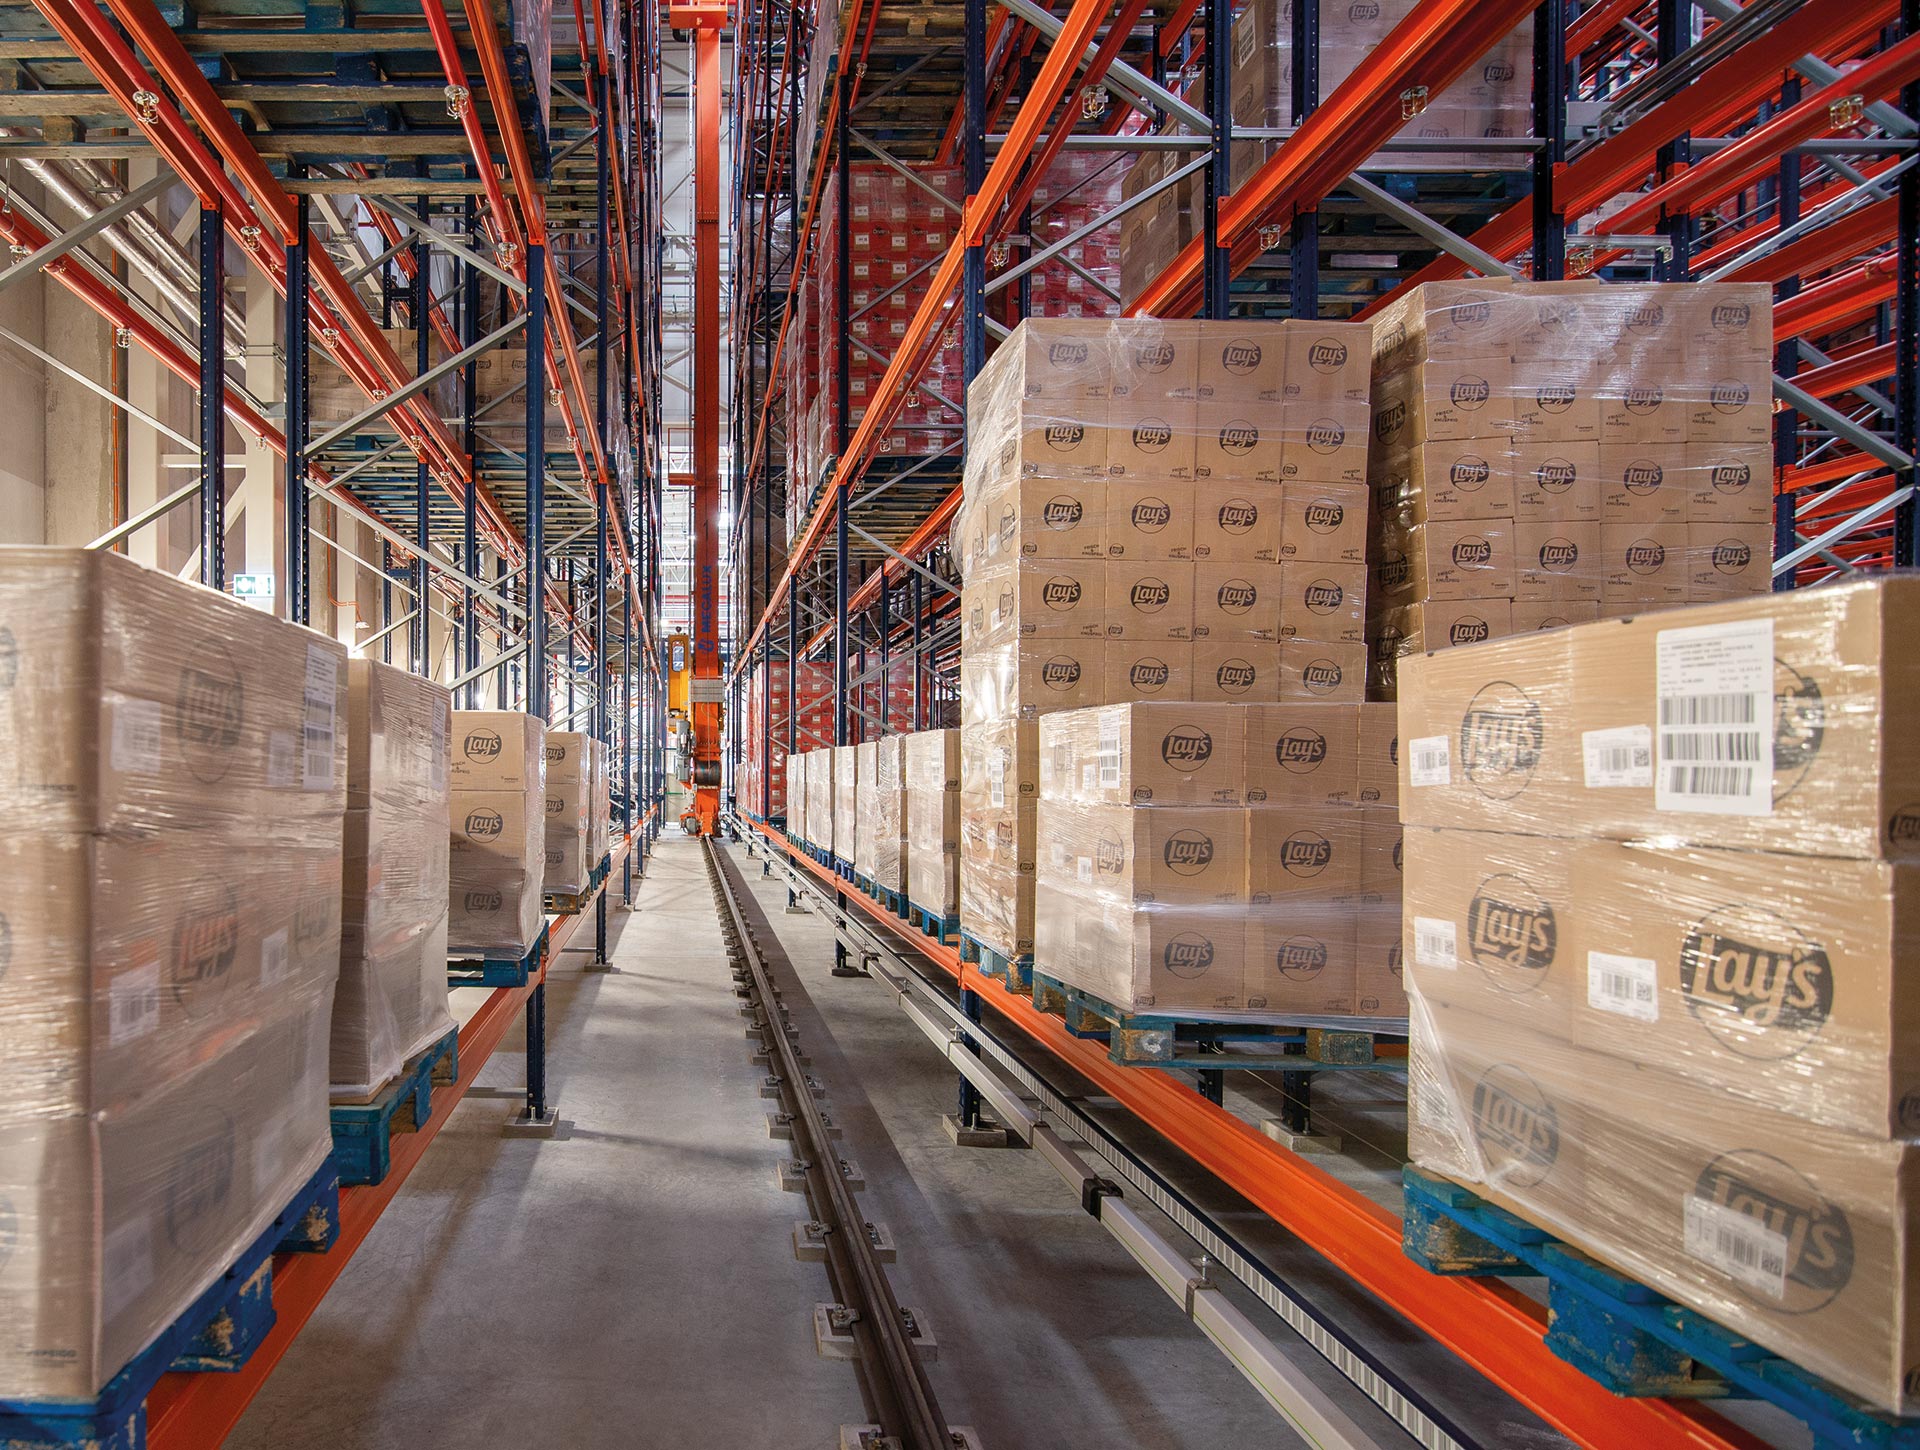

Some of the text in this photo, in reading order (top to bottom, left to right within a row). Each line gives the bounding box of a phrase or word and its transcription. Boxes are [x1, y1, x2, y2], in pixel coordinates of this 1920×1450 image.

[1486, 65, 1512, 81] Lay's
[1715, 305, 1747, 325] Lay's
[1052, 343, 1084, 363] Lay's
[1226, 346, 1258, 366] Lay's
[1312, 345, 1344, 365] Lay's
[1454, 382, 1486, 402] Lay's
[1049, 423, 1081, 443] Lay's
[1136, 425, 1168, 445] Lay's
[1223, 427, 1255, 447] Lay's
[1309, 426, 1341, 446] Lay's
[1541, 465, 1573, 485] Lay's
[1627, 467, 1659, 487] Lay's
[1715, 466, 1747, 486] Lay's
[1047, 503, 1079, 523] Lay's
[1135, 505, 1167, 525] Lay's
[1222, 506, 1254, 526] Lay's
[1308, 506, 1340, 526] Lay's
[1543, 544, 1575, 564] Lay's
[1629, 546, 1661, 566] Lay's
[1716, 546, 1748, 566] Lay's
[702, 565, 712, 632] MECALUX
[1046, 583, 1078, 603] Lay's
[1134, 585, 1166, 605] Lay's
[1221, 586, 1253, 606] Lay's
[1308, 586, 1340, 606] Lay's
[1046, 662, 1078, 682] Lay's
[1133, 665, 1165, 685] Lay's
[1220, 666, 1252, 686] Lay's
[1307, 666, 1339, 686] Lay's
[467, 735, 499, 755] Lay's
[546, 749, 564, 761] ay's
[1166, 734, 1208, 760] Lay's
[1280, 736, 1322, 762] Lay's
[546, 801, 562, 812] ay's
[469, 816, 499, 834] Lay's
[546, 851, 562, 863] ay's
[1168, 838, 1210, 864] Lay's
[1286, 840, 1327, 866] Lay's
[469, 892, 499, 910] Lay's
[1474, 899, 1550, 966] Lay's
[1168, 942, 1210, 968] Lay's
[1282, 944, 1323, 970] Lay's
[1692, 936, 1822, 1026] Lay's
[1480, 1087, 1551, 1160] Lay's
